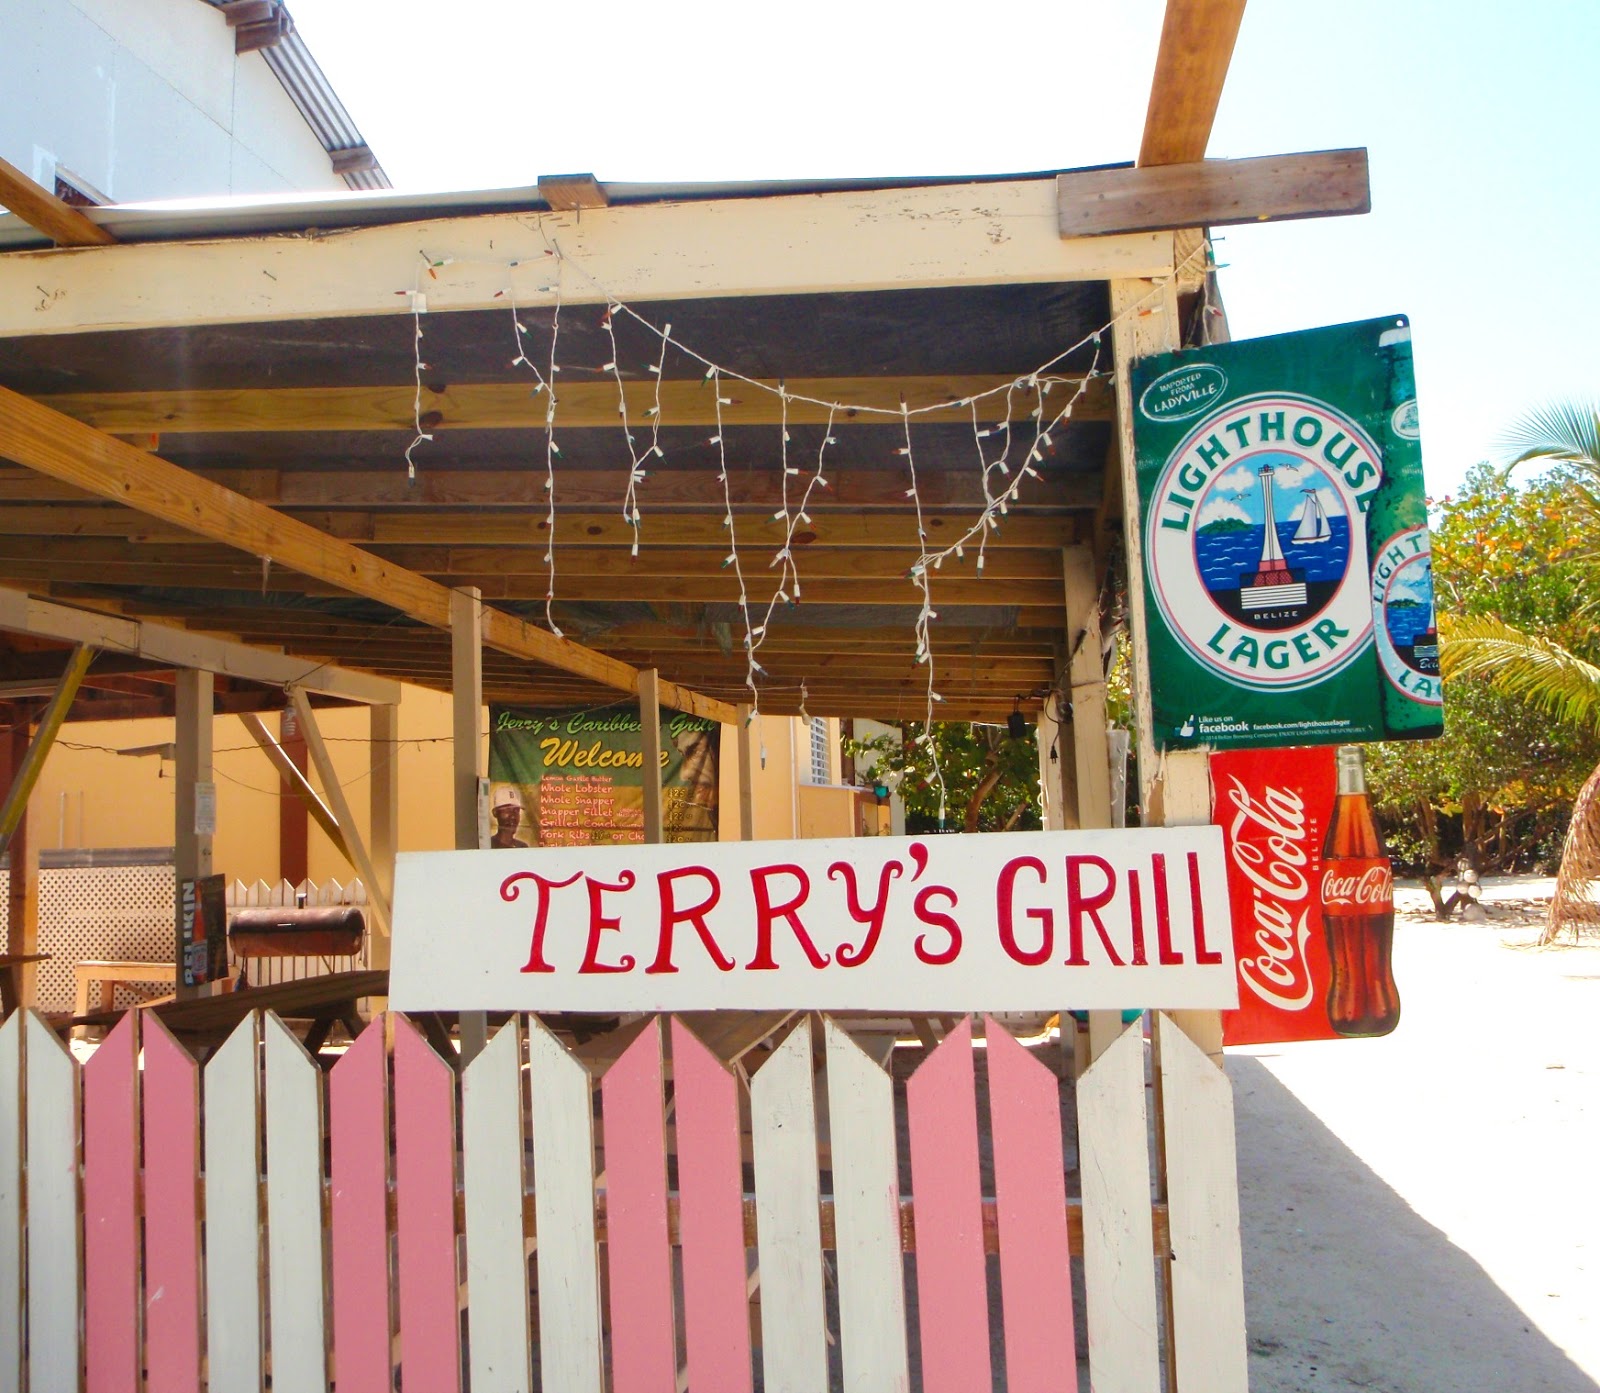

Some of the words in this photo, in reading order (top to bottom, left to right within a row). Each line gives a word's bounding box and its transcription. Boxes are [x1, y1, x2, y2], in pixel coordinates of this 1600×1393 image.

[1159, 372, 1202, 392] IMPORTED
[1170, 382, 1195, 396] FROM
[1154, 383, 1218, 413] LADYVILLE
[1253, 610, 1299, 620] BELIZE
[1206, 617, 1350, 670] LAGER
[566, 711, 662, 734] Caribbe
[1199, 721, 1249, 733] facebook
[541, 784, 571, 793] Whole
[575, 784, 613, 794] Lobster
[540, 795, 571, 804] Whole
[575, 796, 615, 808] Snapper
[540, 806, 580, 820] Snapper
[584, 808, 613, 817] Fillet
[540, 818, 579, 828] Grilled
[584, 818, 616, 828] Conch
[540, 830, 564, 839] Pork
[569, 830, 590, 840] Ribs
[1309, 817, 1319, 871] BELIZE
[1228, 773, 1314, 1011] Coca-Cola
[1321, 866, 1393, 905] Coca-Cola
[996, 851, 1223, 967] GRILL
